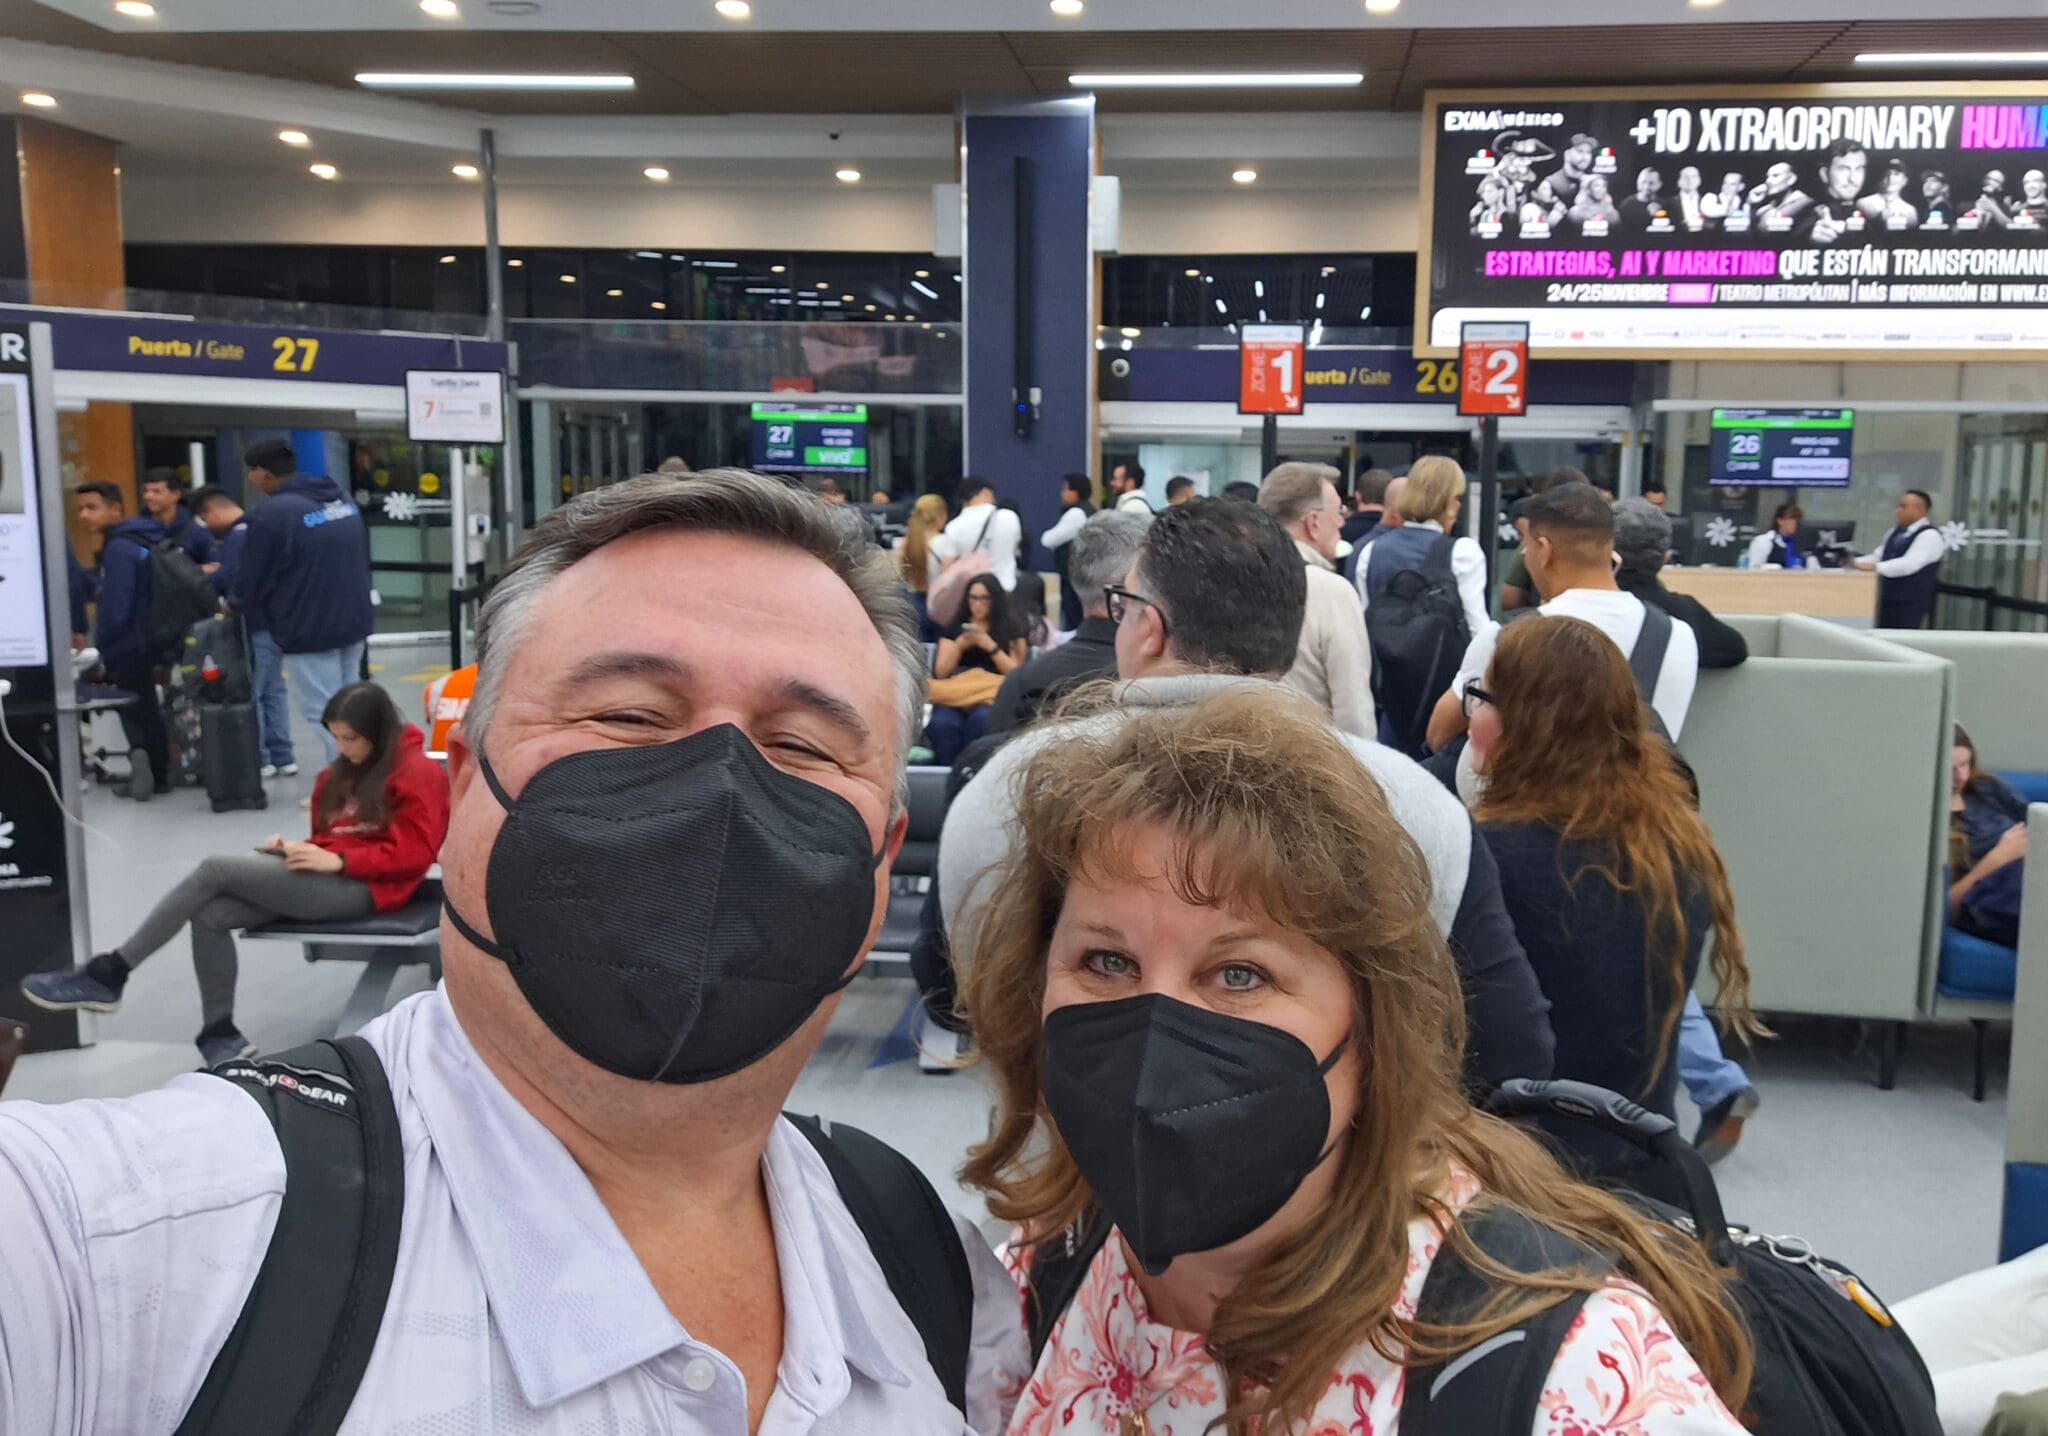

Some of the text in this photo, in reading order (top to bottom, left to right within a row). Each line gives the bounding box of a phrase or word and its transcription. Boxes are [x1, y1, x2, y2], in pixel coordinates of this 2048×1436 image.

[1444, 110, 1501, 131] EXMA
[1629, 107, 1692, 152] +10
[1697, 105, 1955, 152] XTRAORDINARY
[1484, 249, 1616, 280] ESTRATEGIAS,
[1620, 249, 1642, 277] AI
[1645, 249, 1661, 277] Y
[1662, 249, 1776, 277] MARKETING
[1778, 248, 1819, 280] QUE
[1822, 243, 1888, 277] ESTÁN
[1720, 284, 1763, 302] TEATRO
[1858, 281, 1887, 302] MÁS
[1889, 281, 1978, 302] INFORMACIÓN
[1980, 284, 1998, 302] EN
[2000, 284, 2048, 302] WWW.E
[128, 336, 191, 358] Puerta
[206, 340, 245, 361] Gate
[272, 336, 319, 372] 27
[1271, 349, 1294, 394] 1
[1304, 369, 1346, 385] uerta
[1358, 367, 1391, 386] Gate
[1416, 360, 1458, 394] 26
[1468, 351, 1484, 393] ZONE
[1485, 349, 1519, 395] 2
[769, 425, 793, 444] 27
[1731, 434, 1760, 455] 26
[298, 1084, 347, 1106] GEAR
